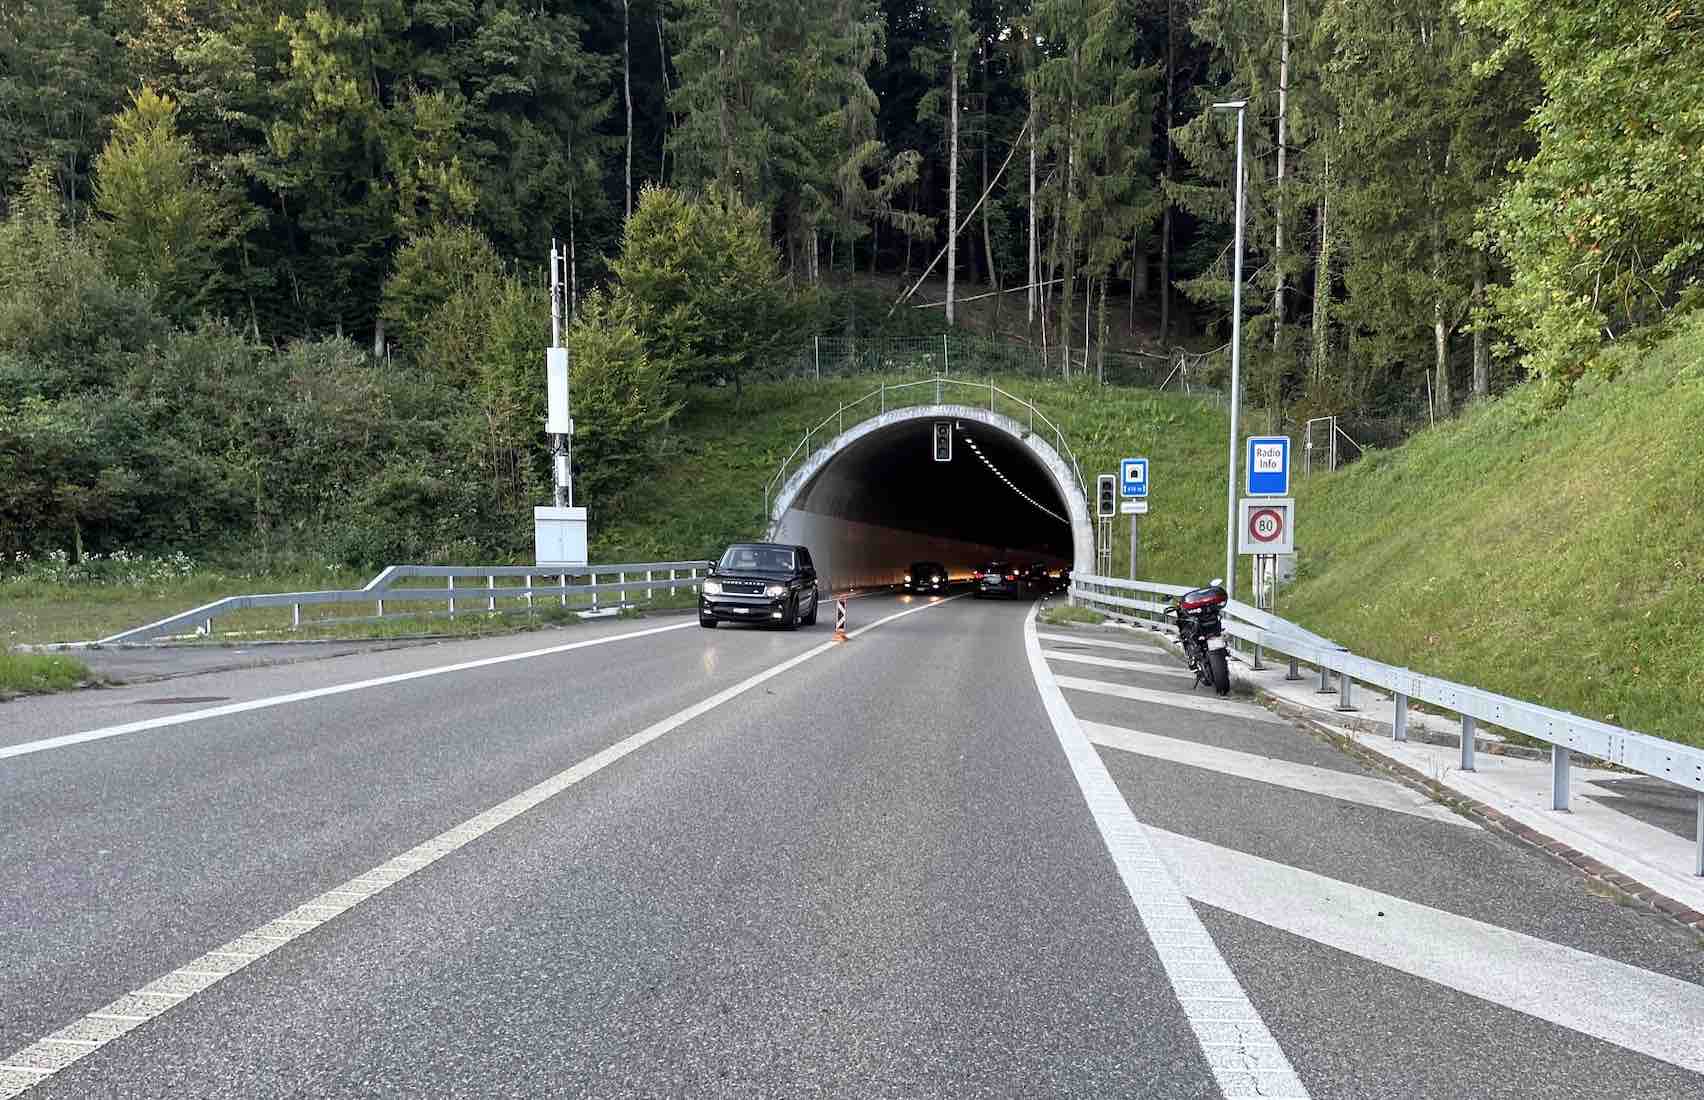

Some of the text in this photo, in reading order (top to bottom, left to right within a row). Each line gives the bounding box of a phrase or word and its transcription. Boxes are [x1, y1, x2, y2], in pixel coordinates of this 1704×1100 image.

[1256, 447, 1281, 457] Radio
[1260, 458, 1277, 469] Info
[1259, 520, 1273, 532] 80
